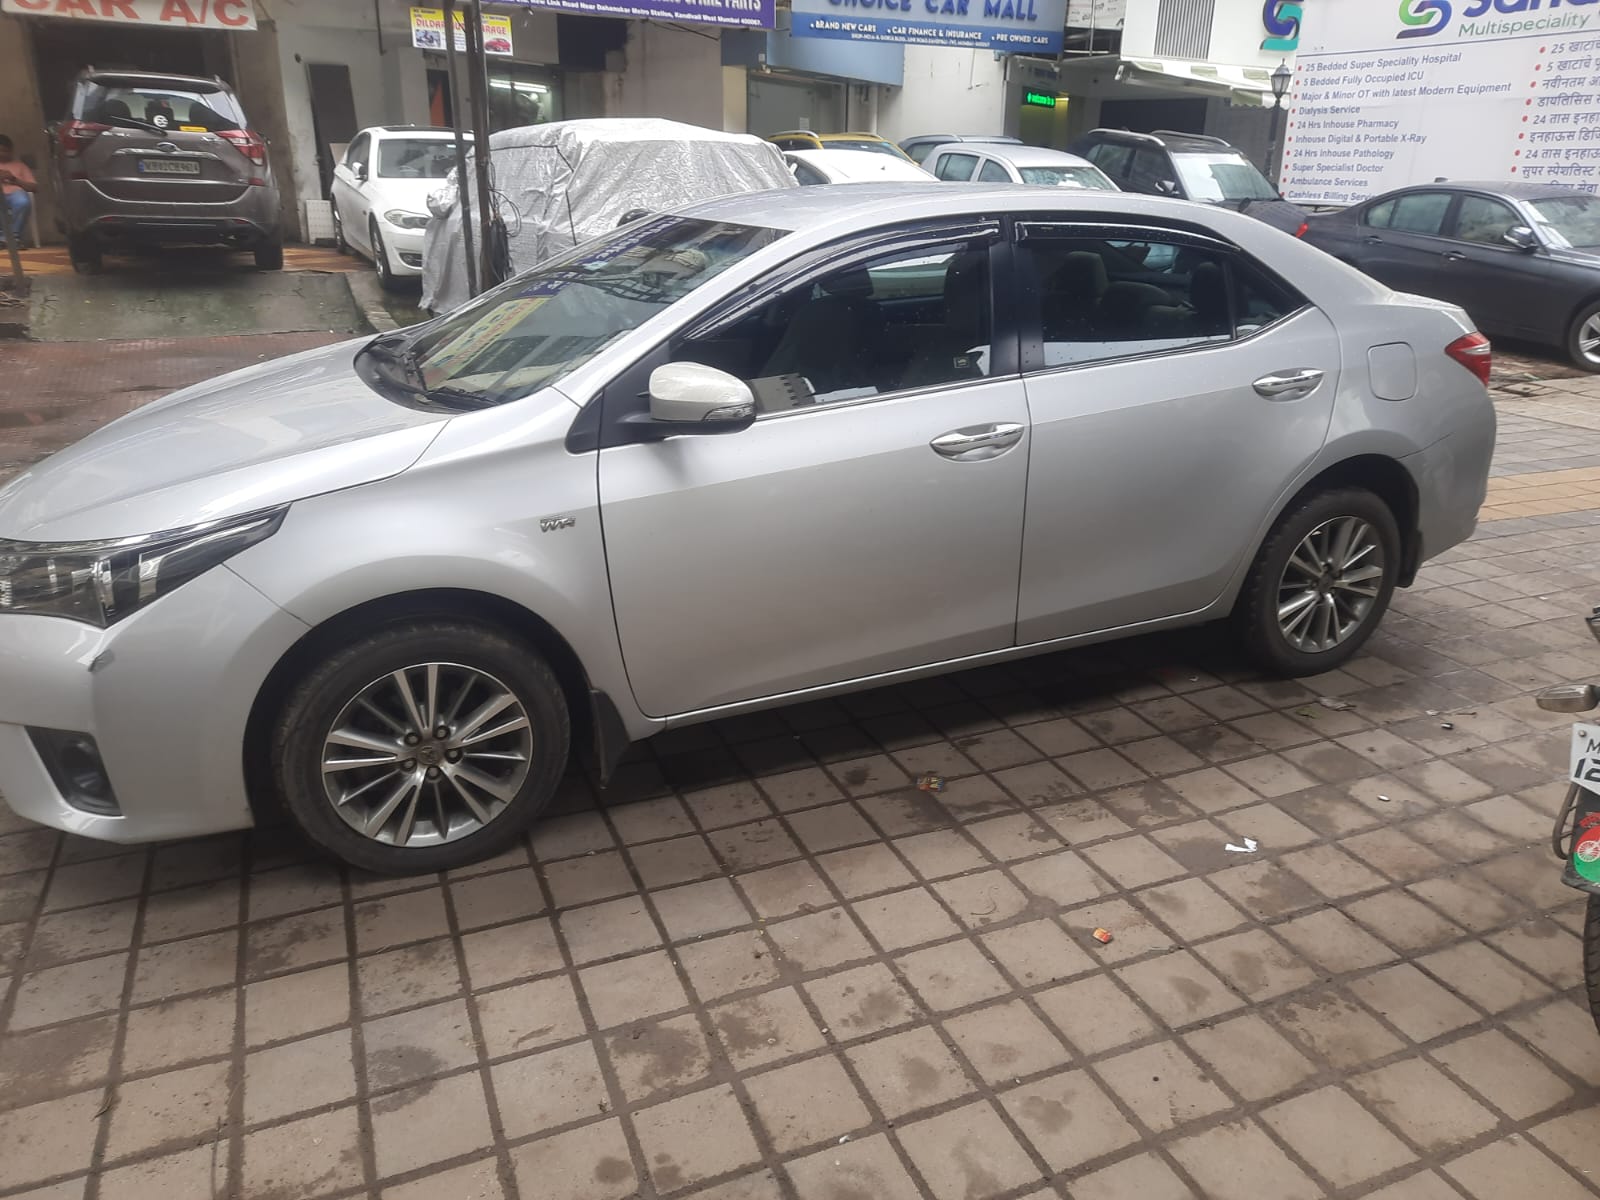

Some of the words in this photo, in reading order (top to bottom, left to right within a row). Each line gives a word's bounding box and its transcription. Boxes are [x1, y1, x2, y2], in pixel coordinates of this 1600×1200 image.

[984, 0, 1038, 21] MALL
[815, 20, 840, 30] BRAND
[841, 22, 857, 31] NEW
[858, 24, 877, 33] CARS
[1458, 13, 1592, 37] Multispeciality
[892, 26, 907, 35] CAR
[908, 27, 937, 37] FINANCE
[945, 30, 983, 40] INSURANCE
[996, 33, 1008, 42] PRE
[1009, 34, 1031, 43] OWNED
[1032, 36, 1049, 44] CARS
[1551, 42, 1566, 54] 25
[1316, 61, 1348, 71] Bedded
[1349, 59, 1375, 70] Super
[1377, 55, 1419, 69] Speciality
[1422, 52, 1462, 64] Hospital
[1546, 61, 1554, 72] 5
[1309, 76, 1340, 86] Bedded
[1342, 75, 1363, 85] Fully
[1364, 72, 1406, 84] Occupied
[1407, 71, 1424, 80] ICU
[1301, 92, 1321, 102] Major
[1331, 91, 1356, 99] Minor
[1357, 89, 1370, 98] OT
[1372, 88, 1390, 97] with
[1391, 87, 1416, 97] latest
[1418, 86, 1454, 96] Modern
[1457, 82, 1512, 95] Equipment
[1298, 106, 1328, 116] Dialysis
[1329, 105, 1361, 114] Service
[1308, 120, 1321, 129] Hrs
[1323, 120, 1355, 128] Inhouse
[1357, 119, 1399, 129] Pharmacy
[1533, 115, 1546, 125] 24
[1295, 135, 1326, 143] Inhouse
[1328, 134, 1354, 144] Digital
[1364, 134, 1399, 143] Portable
[1400, 133, 1427, 144] X-Ray
[1304, 149, 1318, 157] Hrs
[1320, 149, 1351, 157] Inhouse
[1353, 148, 1395, 159] Pathology
[1525, 149, 1538, 159] 24
[1292, 163, 1314, 172] Super
[1316, 163, 1354, 173] Specialist
[1356, 163, 1384, 172] Doctor
[1290, 177, 1333, 186] Ambulance
[1334, 178, 1368, 187] Services
